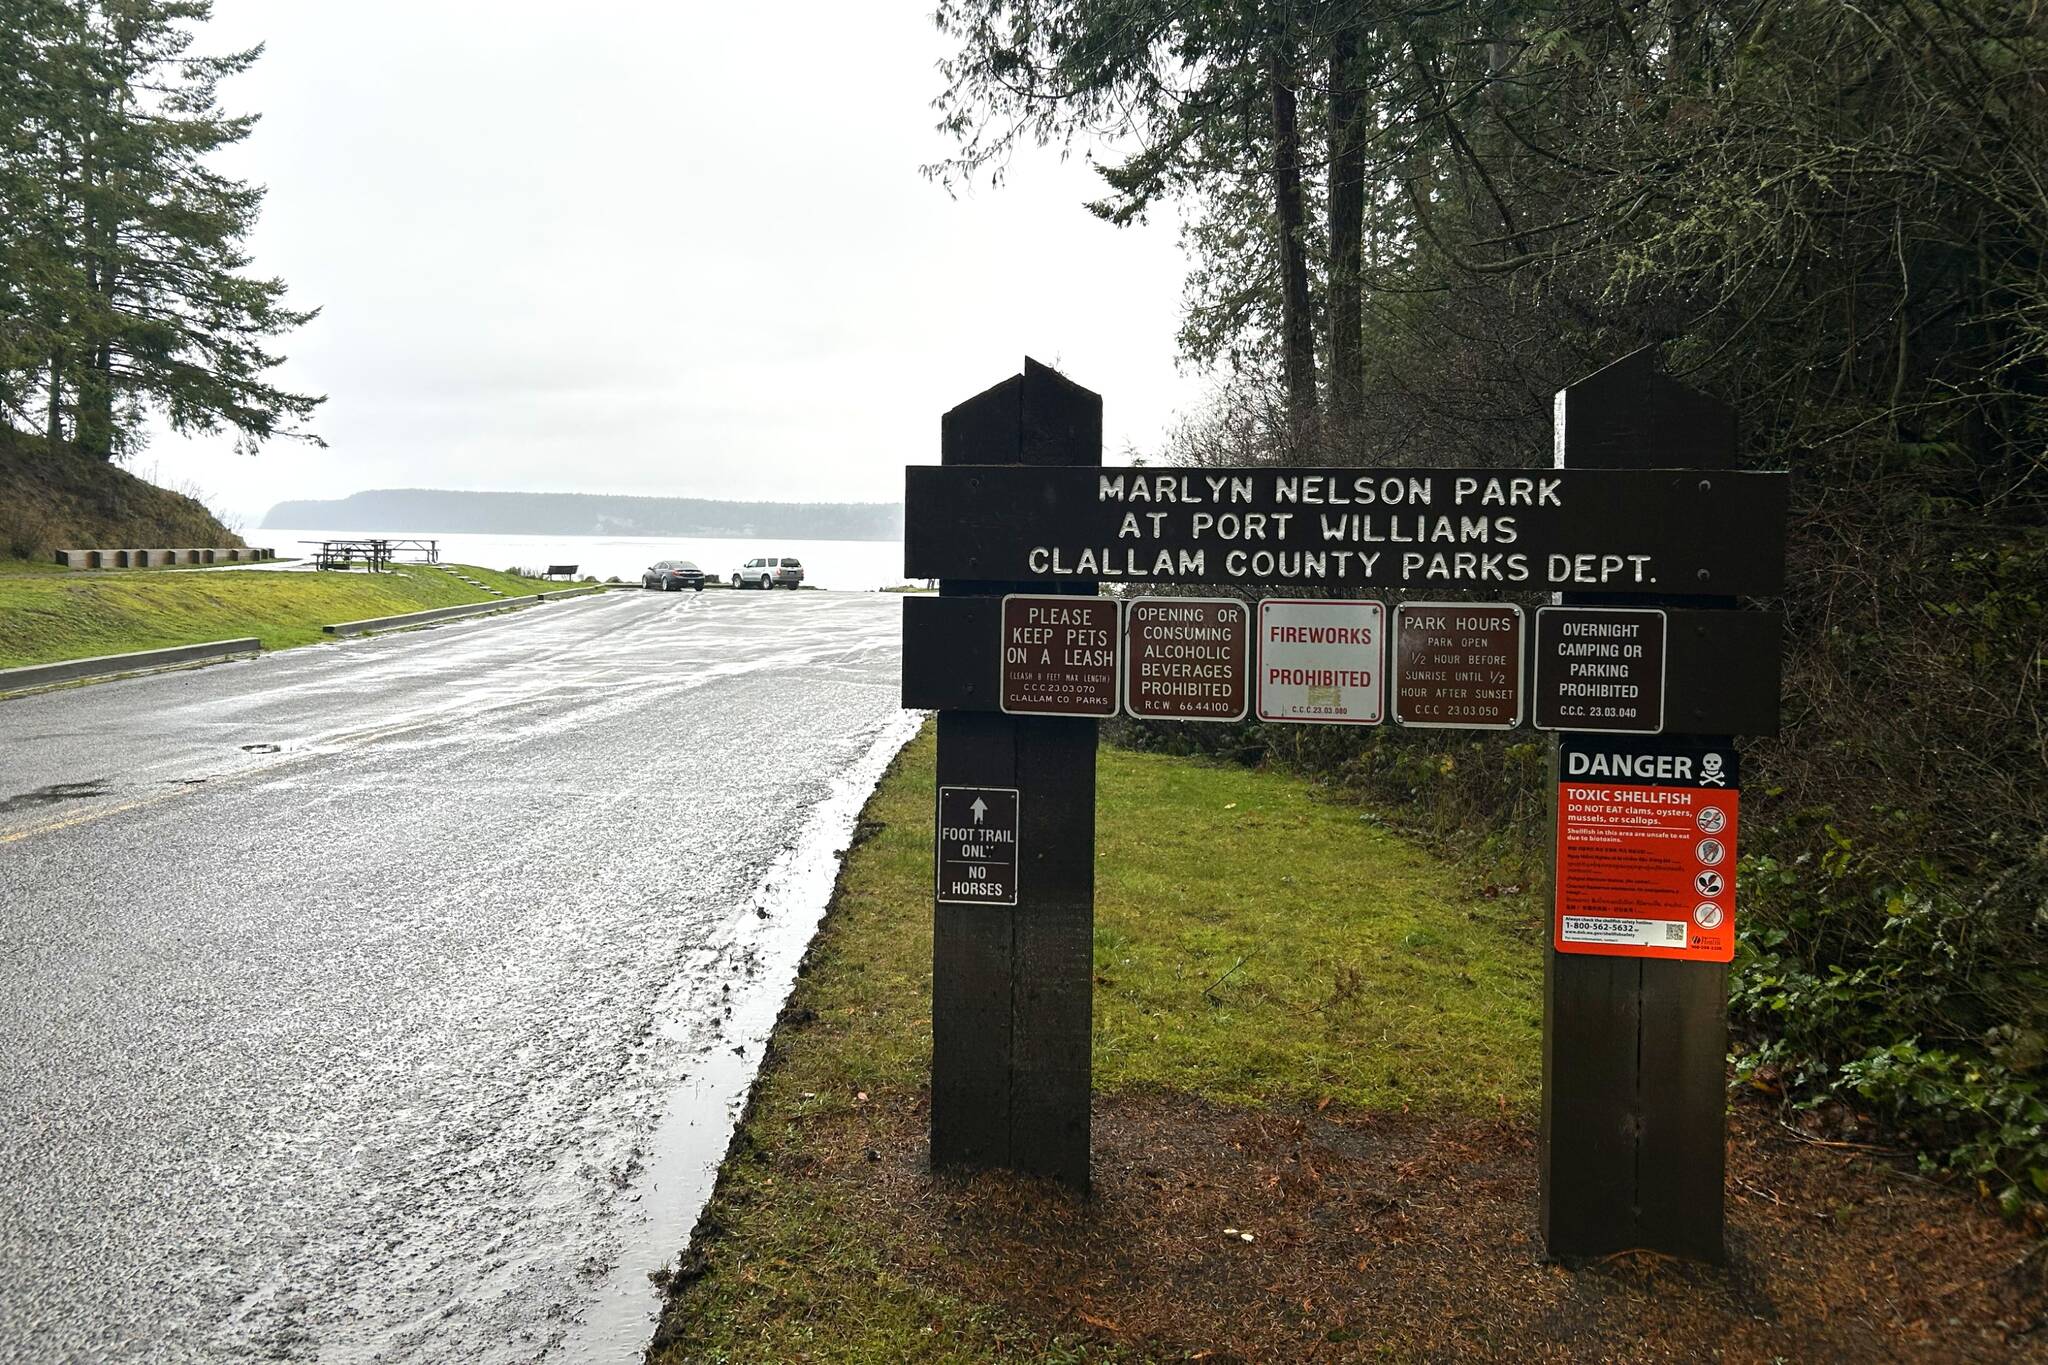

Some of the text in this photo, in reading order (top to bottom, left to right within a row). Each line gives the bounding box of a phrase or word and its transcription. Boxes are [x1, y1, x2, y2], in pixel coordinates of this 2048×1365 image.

[1099, 474, 1562, 506] MARLYN NELSON PARK
[1118, 511, 1518, 544] AT PORT WILLIAMS
[1028, 546, 1657, 583] CLALLAM COUNTY PARKS DEPT.
[1029, 607, 1092, 626] PLEASE
[1137, 607, 1238, 623] OPENING OR
[1404, 616, 1511, 632] PARK HOURS
[1562, 622, 1640, 638] OVERNIGHT
[1013, 627, 1108, 646] KEEP PETS
[1143, 626, 1232, 641] CONSUMING
[1270, 626, 1371, 645] FIREWORKS
[1427, 637, 1488, 648] PARK OPEN
[1558, 642, 1643, 658] CAMPING OR
[1006, 647, 1113, 667] ON A LEASH
[1144, 644, 1231, 660] ALCOHOLIC
[1434, 654, 1460, 664] HOUR
[1468, 655, 1507, 665] BEFORE
[1046, 673, 1060, 681] FEET
[1141, 663, 1233, 679] BEVERAGES
[1269, 668, 1371, 688] PROHIBITED
[1405, 671, 1447, 681] SUNRISE
[1455, 671, 1484, 682] UNTIL
[1570, 663, 1629, 678] PARKING
[1141, 681, 1232, 697] PROHIBITED
[1401, 687, 1513, 700] HOUR AFTER SUNSET
[1559, 683, 1639, 698] PROHIBITED
[1009, 693, 1053, 703] CLALLAM
[1076, 696, 1108, 705] PARKS
[1560, 705, 1637, 718] C.C.C. 23.03.040
[1568, 752, 1693, 779] DANGER
[1567, 788, 1691, 805] TOXIC SHELLFISH
[1567, 804, 1693, 818] DO NOT EAT clams, oysters,
[1567, 814, 1661, 826] mussels, or scallops.
[942, 827, 1015, 843] FOOT TRAIL
[1605, 829, 1618, 837] this
[1646, 831, 1669, 839] unsafe
[968, 865, 987, 880] NO
[952, 881, 1003, 896] HORSES
[1565, 922, 1634, 932] 1-800-562-5632
